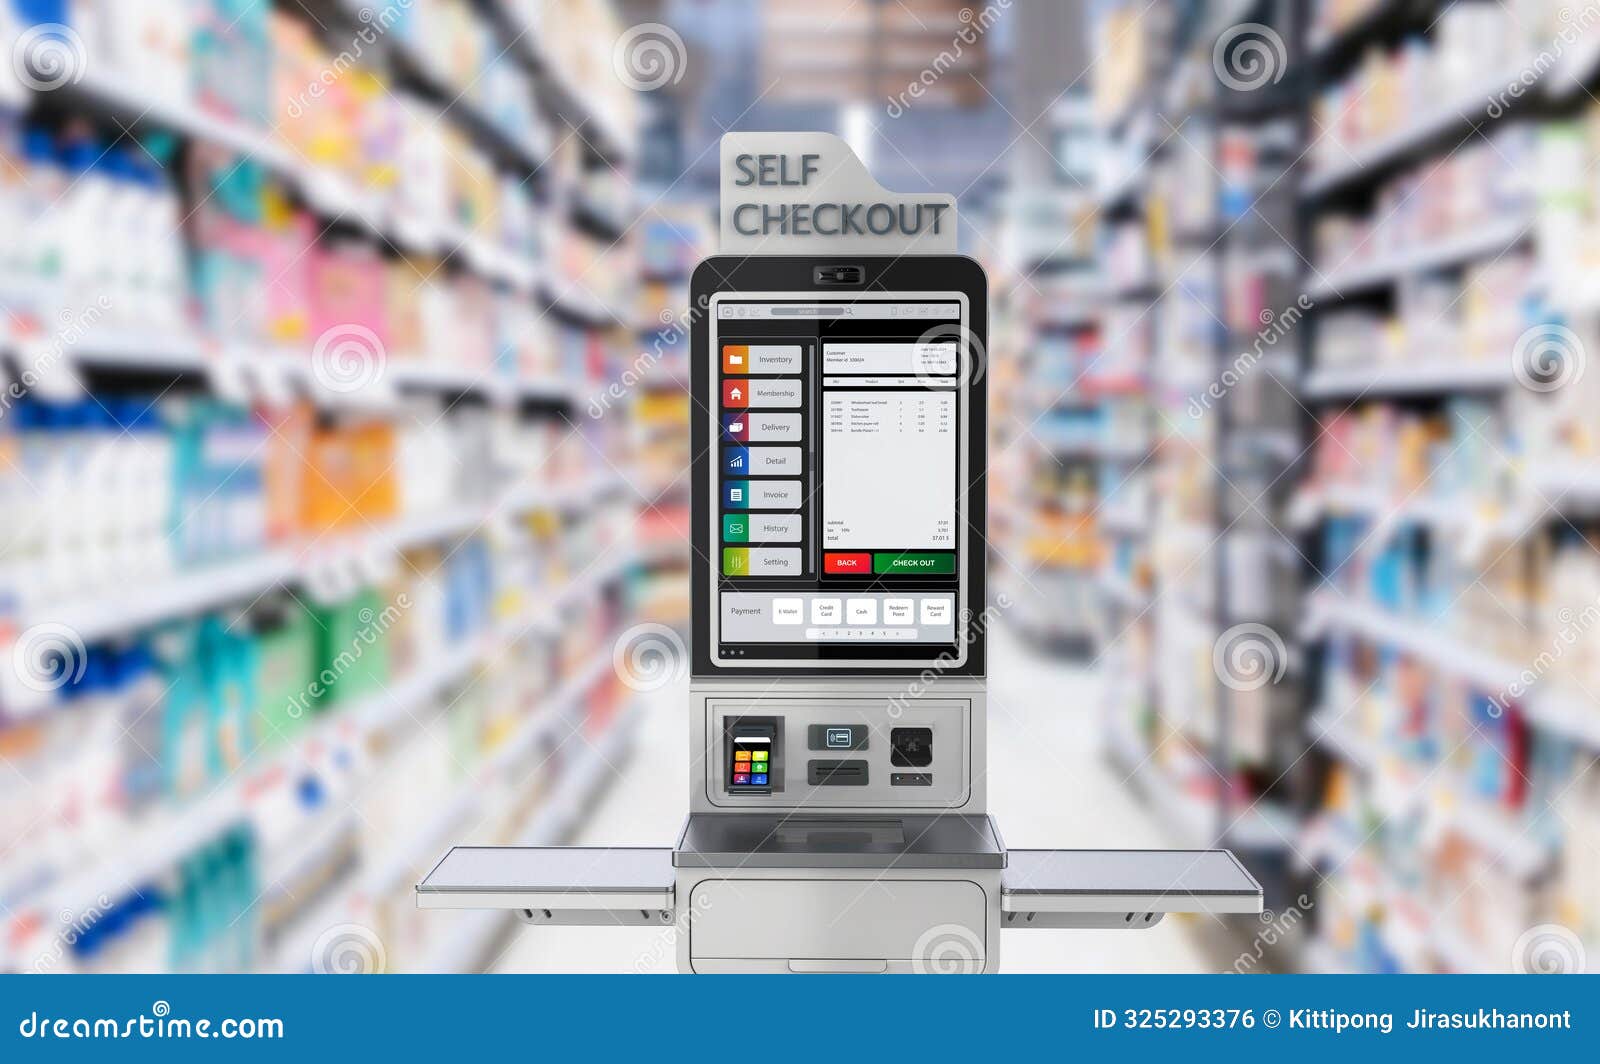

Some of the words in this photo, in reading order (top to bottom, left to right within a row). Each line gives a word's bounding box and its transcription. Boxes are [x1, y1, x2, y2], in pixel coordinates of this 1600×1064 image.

[734, 153, 820, 187] SELF
[732, 202, 950, 236] CHECKOUT
[759, 356, 793, 365] Inventory
[756, 390, 795, 398] Membership
[761, 423, 791, 432] Delivery
[765, 457, 787, 465] Detail
[763, 491, 789, 499] Invoice
[763, 525, 789, 534] History
[763, 558, 789, 567] Setting
[837, 559, 857, 567] BACK
[892, 559, 918, 567] CHECK
[919, 559, 935, 567] OUT
[730, 607, 761, 616] Payment
